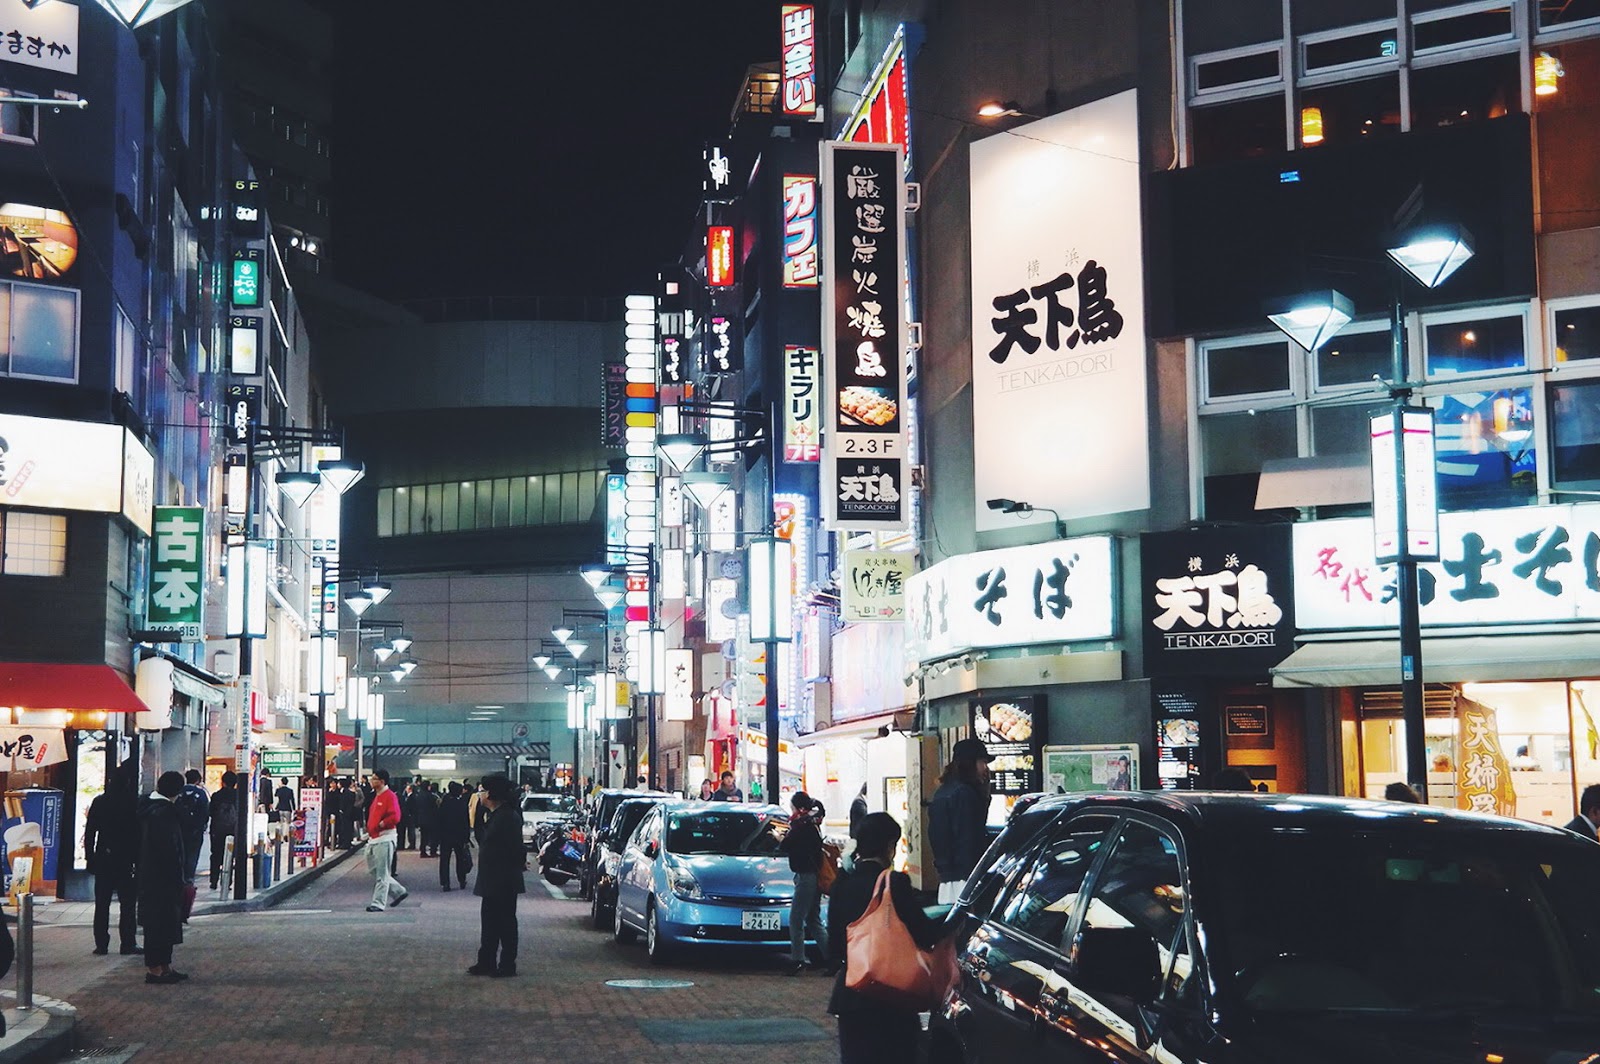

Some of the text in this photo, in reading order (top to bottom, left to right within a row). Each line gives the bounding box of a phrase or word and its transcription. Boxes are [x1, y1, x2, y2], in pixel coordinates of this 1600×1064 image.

[0, 29, 71, 60] ますか
[783, 8, 814, 112] 出会い
[785, 180, 816, 283] カフェ
[988, 259, 1124, 365] 天下鳥
[789, 347, 814, 422] キラリ
[998, 353, 1114, 391] TENKADORI
[787, 445, 818, 461] 7F
[842, 503, 896, 511] TENKADORI
[152, 515, 199, 614] 古本
[1187, 553, 1240, 572] 横浜
[1312, 547, 1373, 603] 名代
[1152, 564, 1283, 631] 天下鳥
[1164, 632, 1275, 648] TENKADORI
[0, 734, 35, 760] と屋
[751, 918, 779, 930] 24-16
